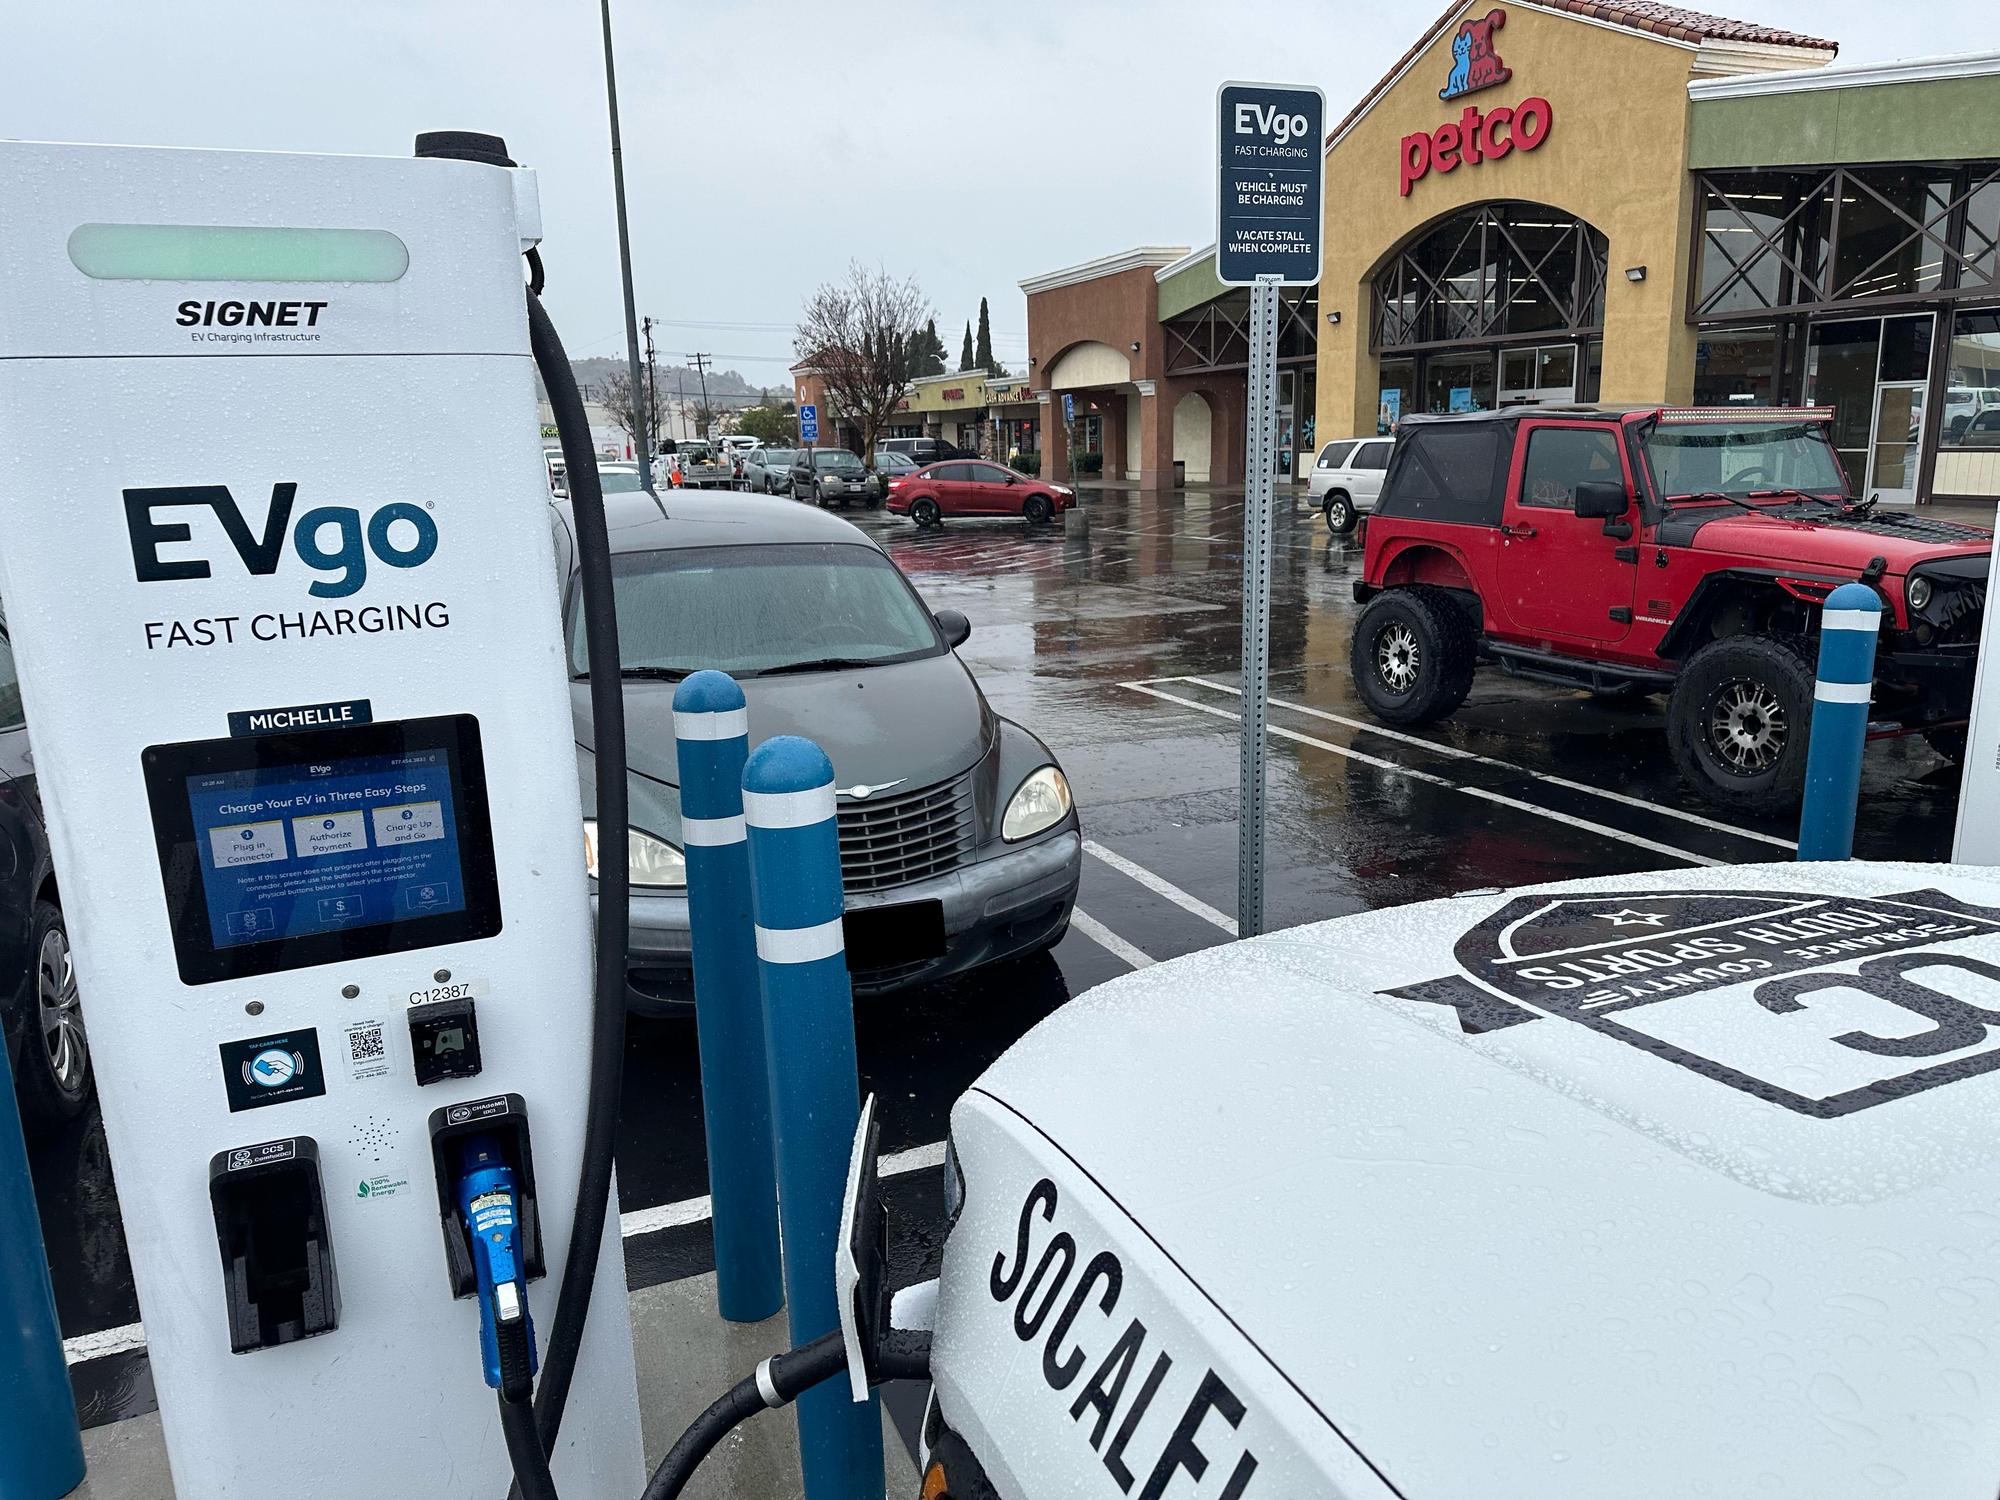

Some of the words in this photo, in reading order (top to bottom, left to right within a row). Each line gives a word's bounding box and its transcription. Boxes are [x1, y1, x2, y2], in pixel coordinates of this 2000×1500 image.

[1235, 103, 1309, 145] EVgo
[1234, 145, 1258, 156] FAST
[1259, 146, 1308, 158] CHARGING
[1400, 96, 1553, 197] petco
[1235, 181, 1277, 192] VEHICLE
[1280, 183, 1308, 194] MUST
[1238, 195, 1251, 204] BE
[1252, 194, 1304, 206] CHARGING
[1236, 230, 1275, 241] VACATE
[1276, 231, 1305, 241] STALL
[1228, 243, 1259, 253] WHEN
[1260, 243, 1311, 253] COMPLETE
[176, 301, 328, 326] SIGNET
[191, 333, 205, 341] EV
[207, 332, 251, 343] Charging
[254, 332, 321, 341] Infrastructure
[145, 616, 240, 649] FAST
[250, 602, 450, 641] CHARGING
[249, 705, 354, 730] MICHELLE
[310, 765, 332, 774] EVgo
[219, 802, 264, 814] Charge
[265, 798, 293, 809] Your
[296, 795, 312, 805] EV
[315, 794, 326, 803] in
[328, 791, 362, 802] Three
[365, 788, 392, 799] Easy
[395, 783, 427, 795] Steps
[386, 822, 418, 833] Charge
[420, 820, 432, 829] Up
[309, 831, 352, 842] Authorize
[395, 833, 411, 841] and
[414, 832, 426, 840] Go
[233, 843, 255, 852] Plug
[312, 842, 352, 853] Payment
[227, 852, 275, 863] Connector
[334, 863, 365, 872] progress
[283, 879, 306, 888] please
[384, 865, 406, 873] screen
[258, 890, 287, 900] physical
[288, 887, 314, 895] buttons
[315, 883, 336, 891] below
[346, 879, 366, 887] select
[367, 877, 382, 885] your
[1734, 907, 1915, 945] YOUTH
[1784, 924, 1931, 960] ORANGE
[1516, 937, 1747, 989] SPORTS
[1621, 958, 1773, 997] COUNTY
[409, 983, 469, 1005] C12387
[472, 1100, 505, 1111] CHAdeMO
[262, 1144, 284, 1154] CCS
[370, 1178, 389, 1186] 100%
[371, 1180, 408, 1191] Renewable
[372, 1189, 395, 1197] Energy
